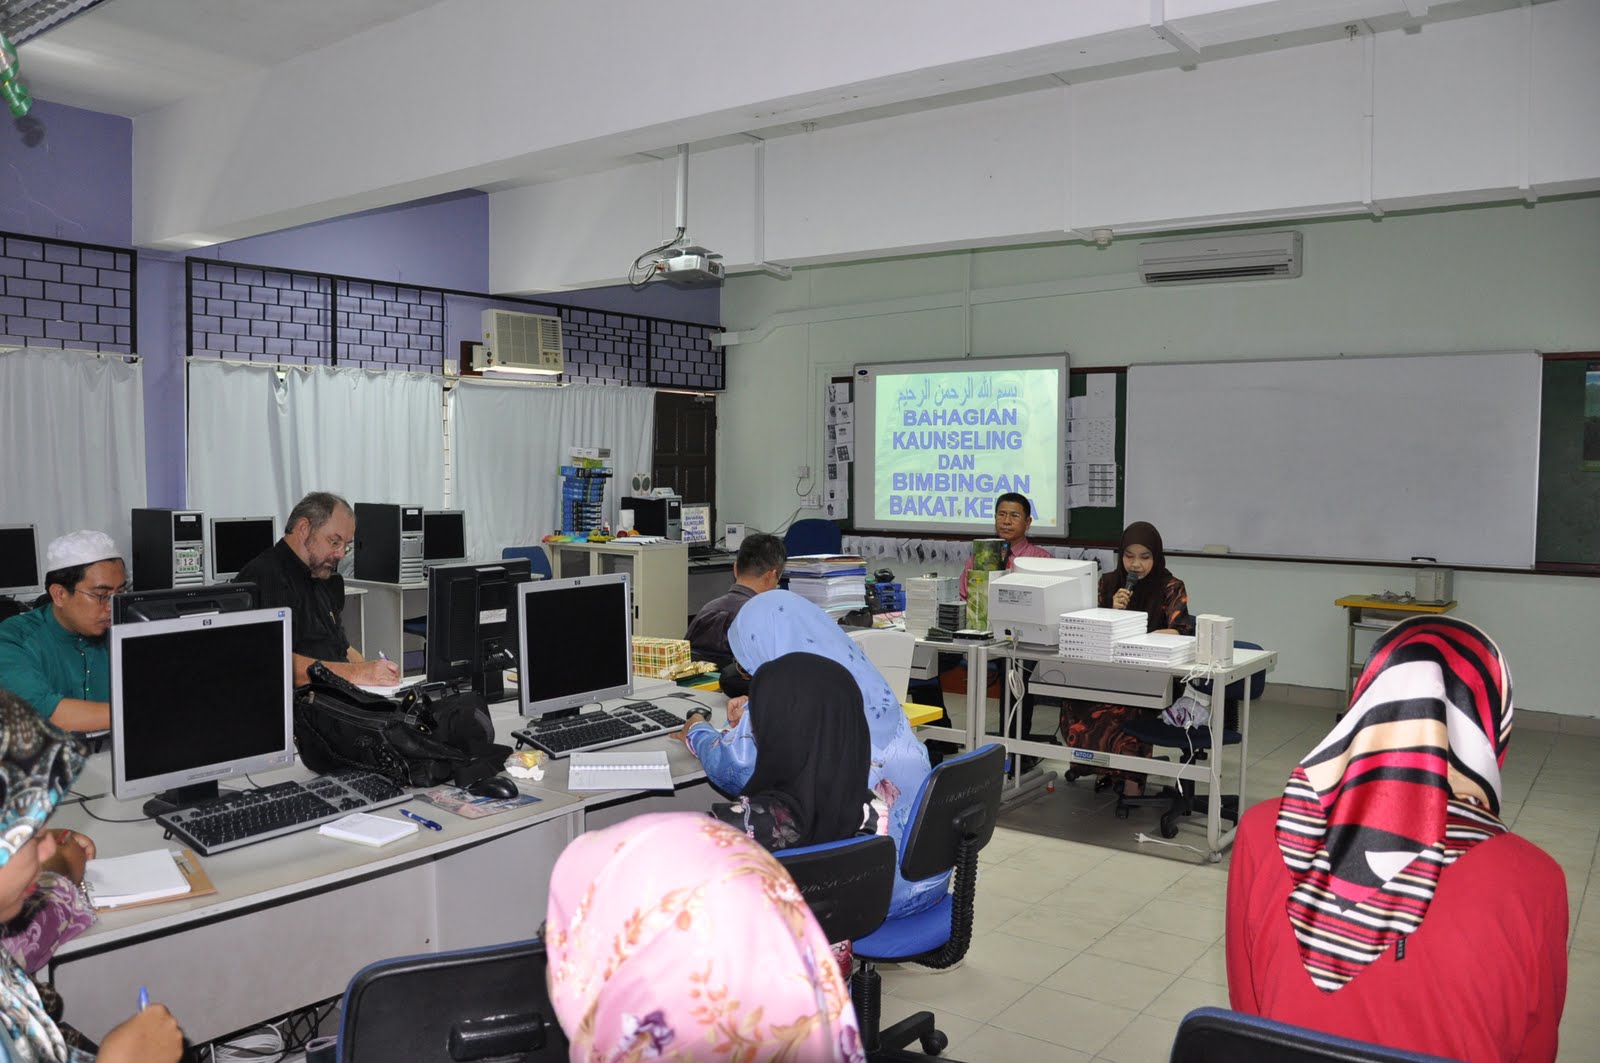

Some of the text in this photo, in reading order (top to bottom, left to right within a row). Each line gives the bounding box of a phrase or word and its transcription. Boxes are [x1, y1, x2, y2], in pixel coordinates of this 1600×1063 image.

[897, 377, 931, 412] الرحيم
[934, 376, 974, 407] الرحمن
[997, 385, 1018, 409] بسم
[903, 408, 1017, 426] BAHAGIAN
[892, 430, 1023, 450] KAUNSELING
[938, 454, 975, 470] DAN
[892, 472, 1031, 494] BIMBINGAN
[889, 495, 1039, 520] BAKAT KEA
[183, 558, 194, 566] 12
